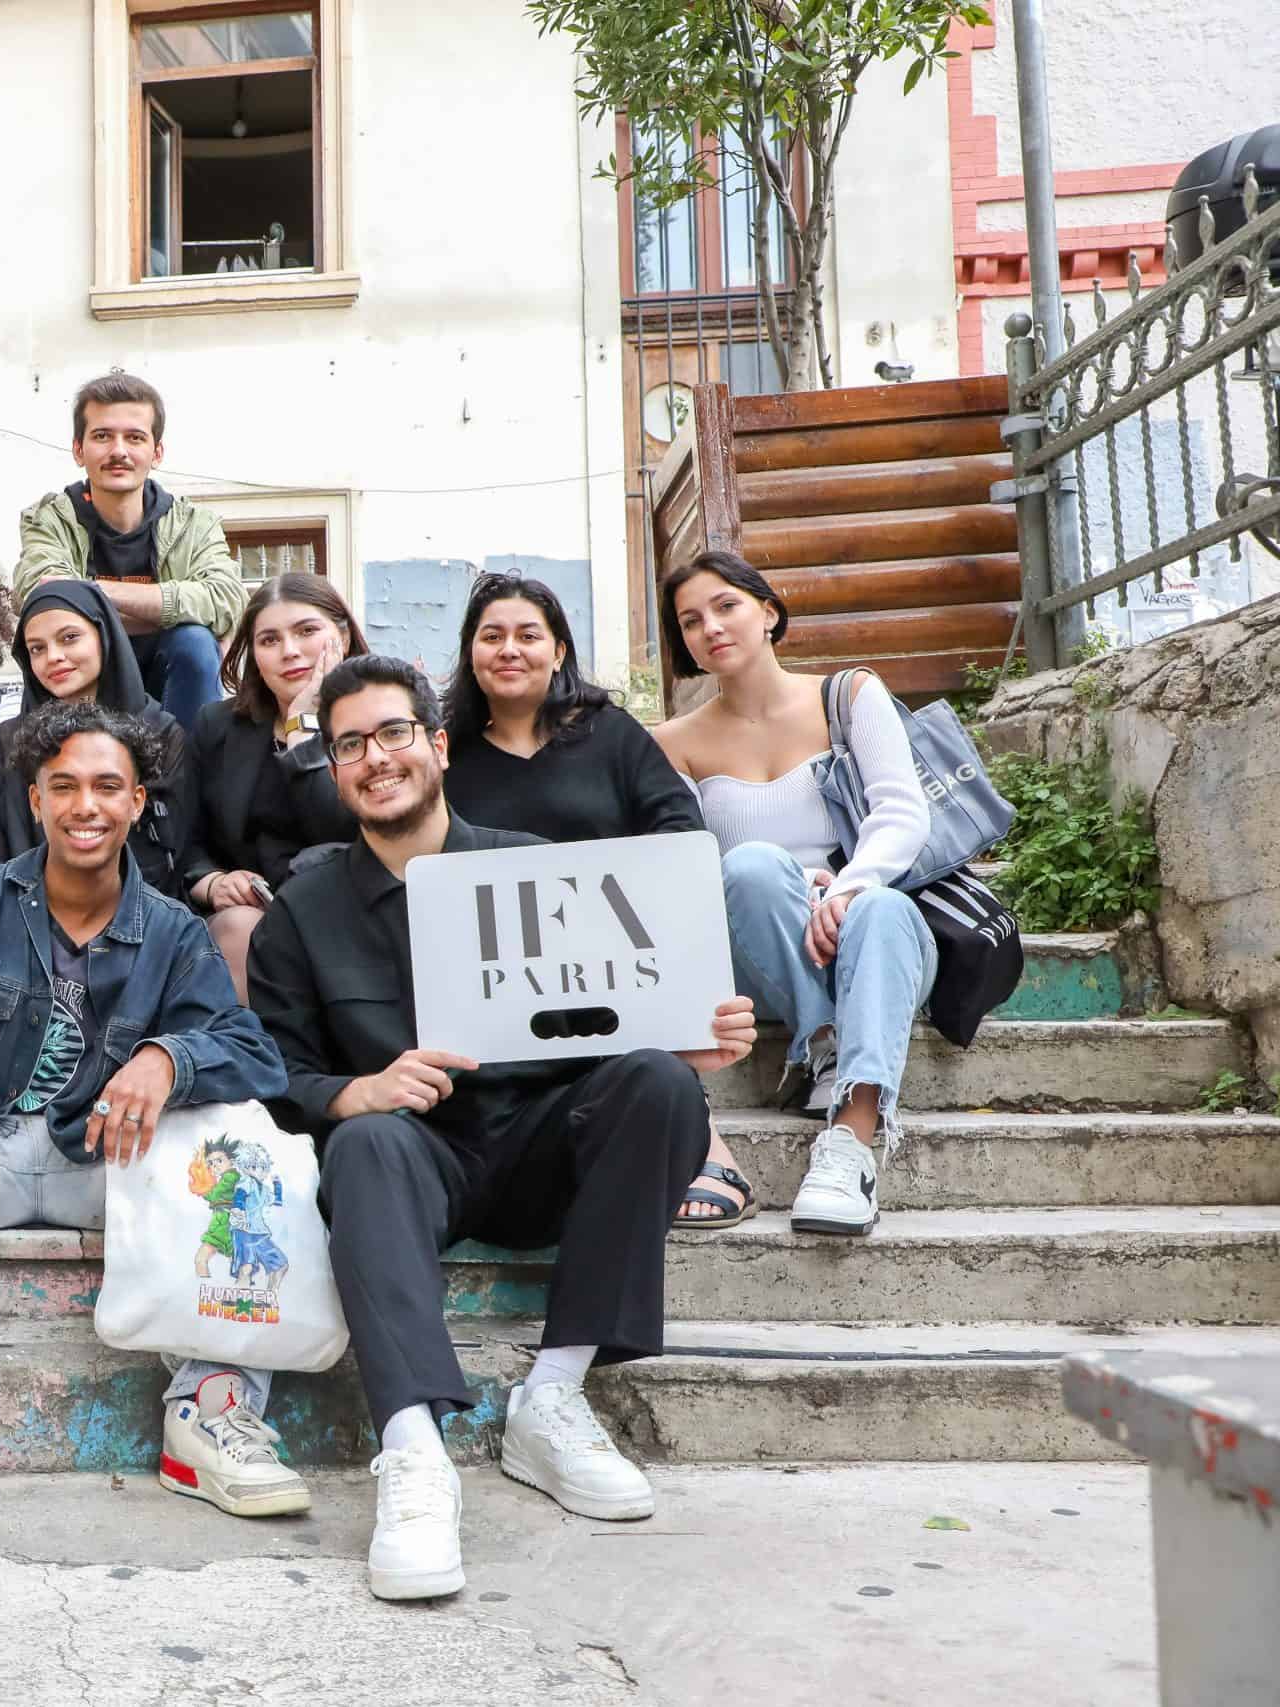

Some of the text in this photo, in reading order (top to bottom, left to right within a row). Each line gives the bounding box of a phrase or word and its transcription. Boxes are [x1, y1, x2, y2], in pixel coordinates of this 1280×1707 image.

[923, 763, 977, 801] BAG
[475, 873, 655, 962] IFA
[482, 957, 660, 1000] PARIS
